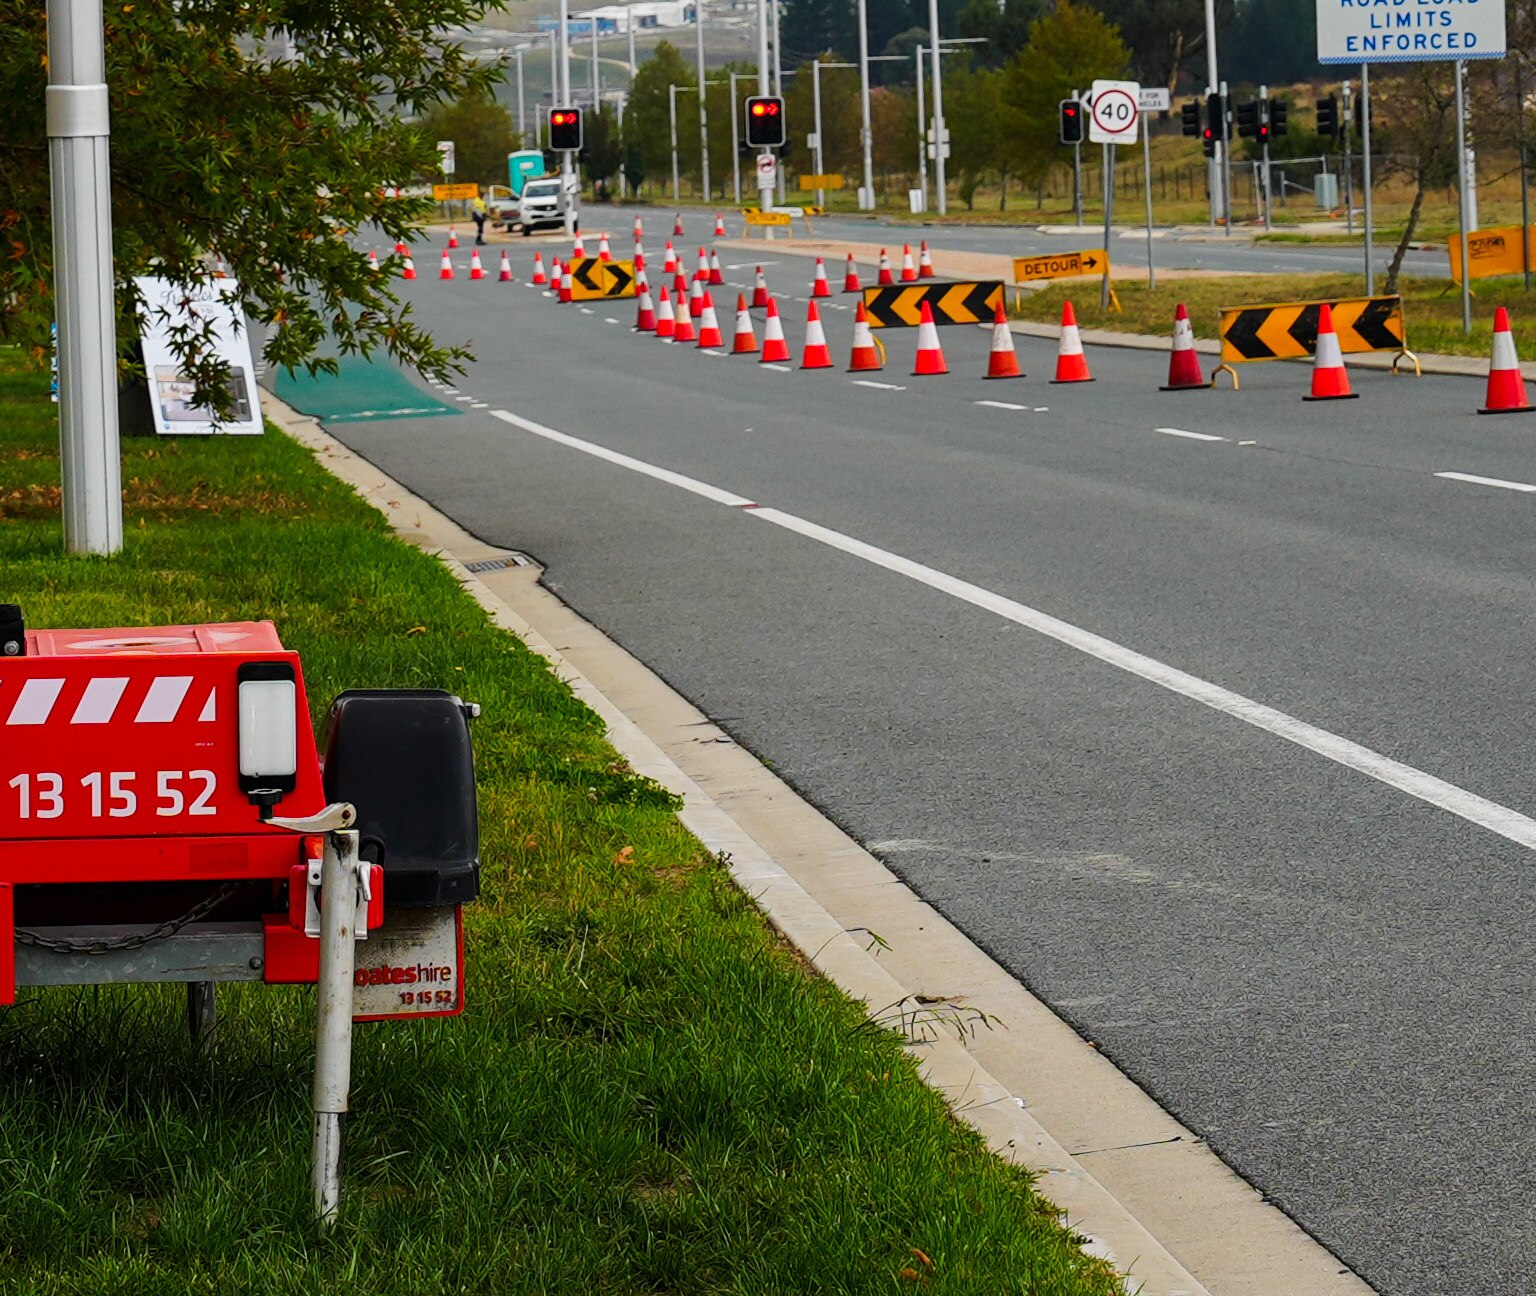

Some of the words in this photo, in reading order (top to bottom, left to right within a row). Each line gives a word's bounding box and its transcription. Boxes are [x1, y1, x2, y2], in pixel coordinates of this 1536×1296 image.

[1370, 10, 1452, 29] LIMITS
[1346, 32, 1477, 52] ENFORCED
[1101, 103, 1129, 121] 40
[1024, 258, 1079, 275] DETOUR
[8, 772, 64, 819] 13
[80, 771, 137, 817] 15
[156, 769, 217, 816] 52
[353, 962, 452, 987] oateshire
[400, 991, 415, 1005] 13
[417, 990, 432, 1004] 15
